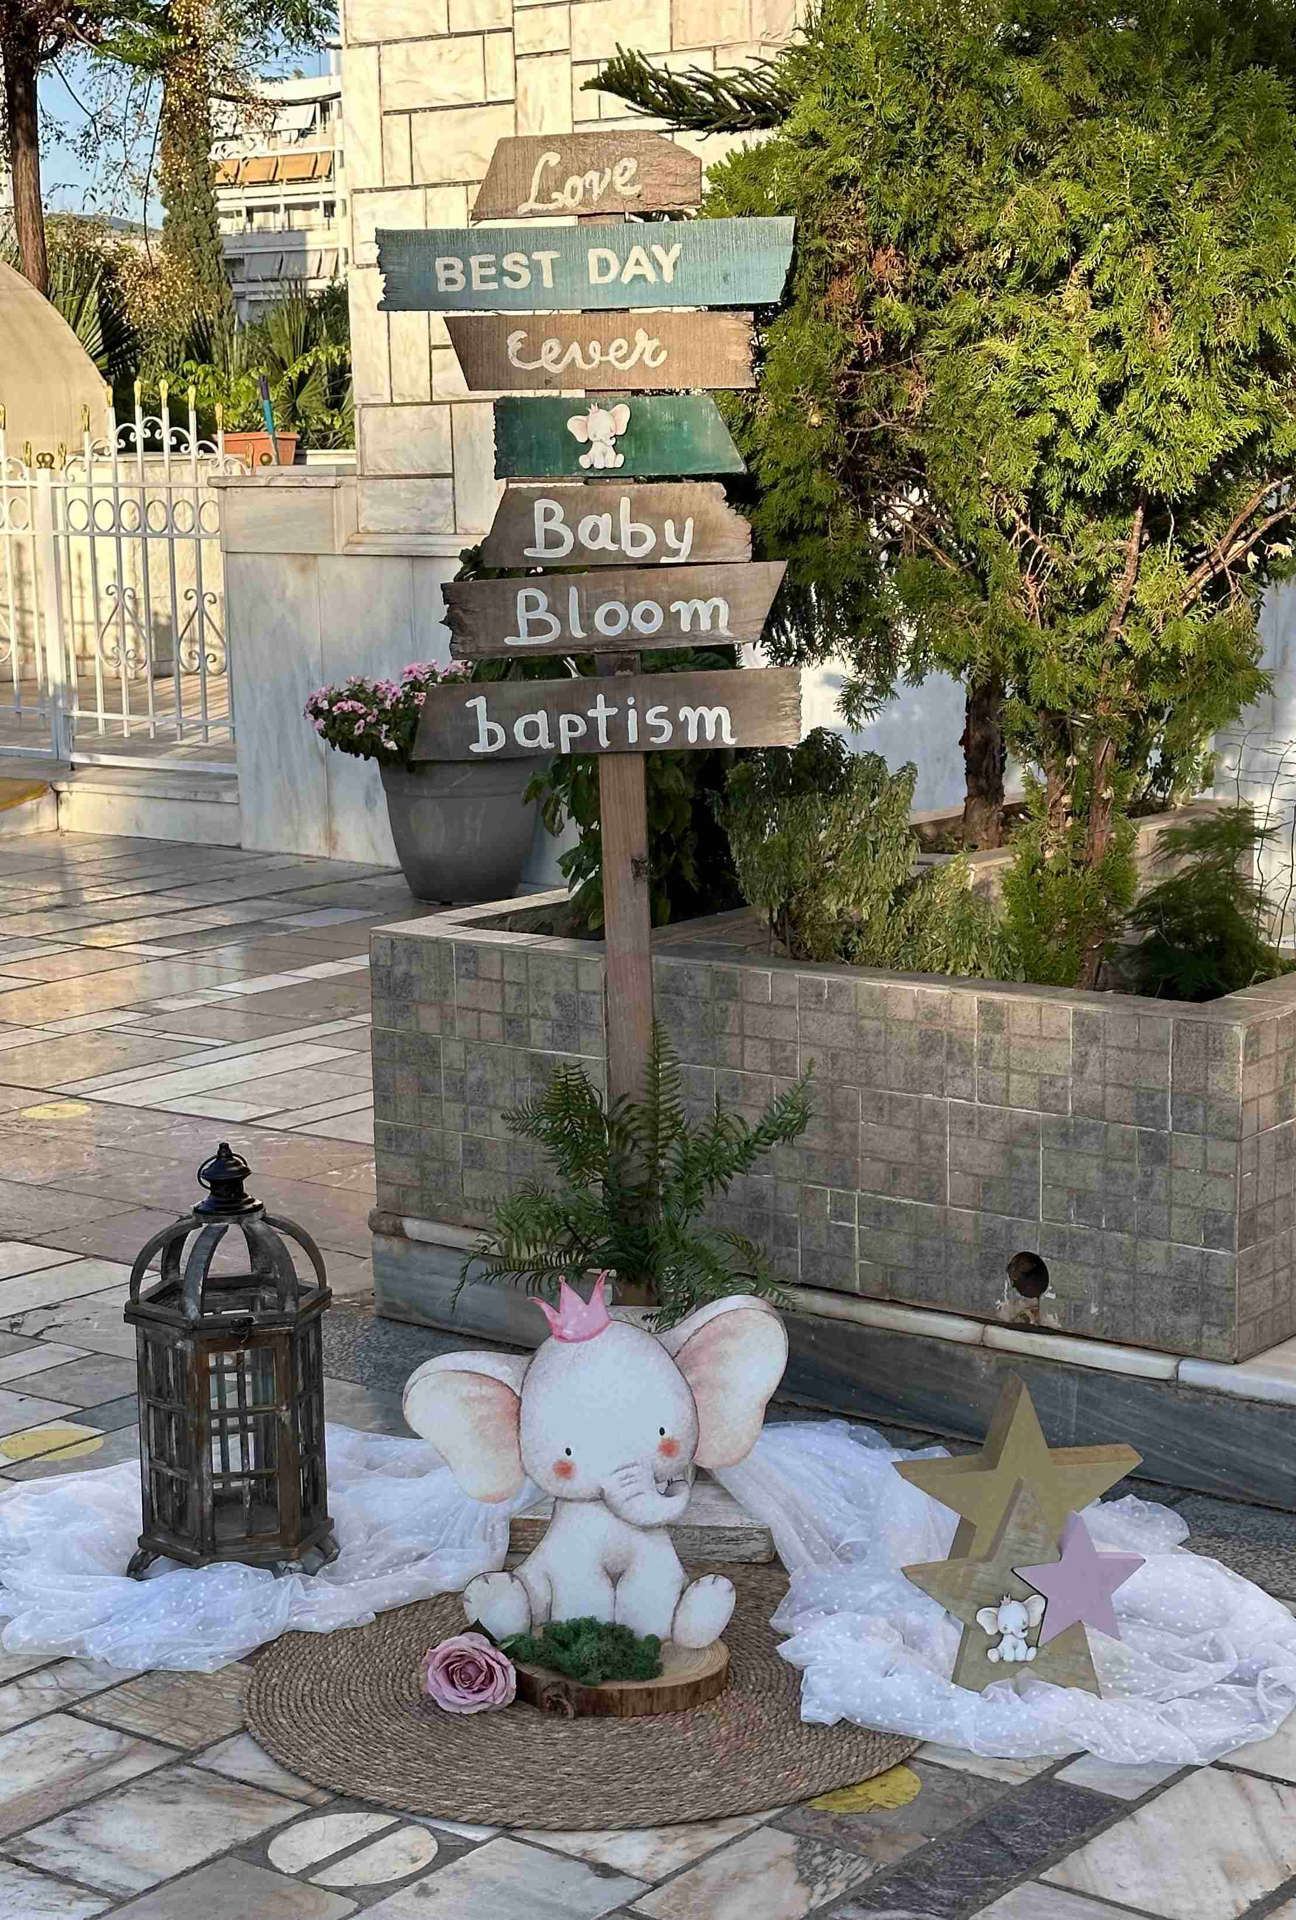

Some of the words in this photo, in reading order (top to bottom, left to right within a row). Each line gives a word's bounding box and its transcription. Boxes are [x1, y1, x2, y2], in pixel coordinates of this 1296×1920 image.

[518, 151, 643, 215] Love
[435, 251, 561, 293] BEST
[588, 243, 683, 285] DAY
[523, 497, 695, 564] Baby
[503, 586, 735, 646] Bloom
[465, 693, 737, 754] baptism
